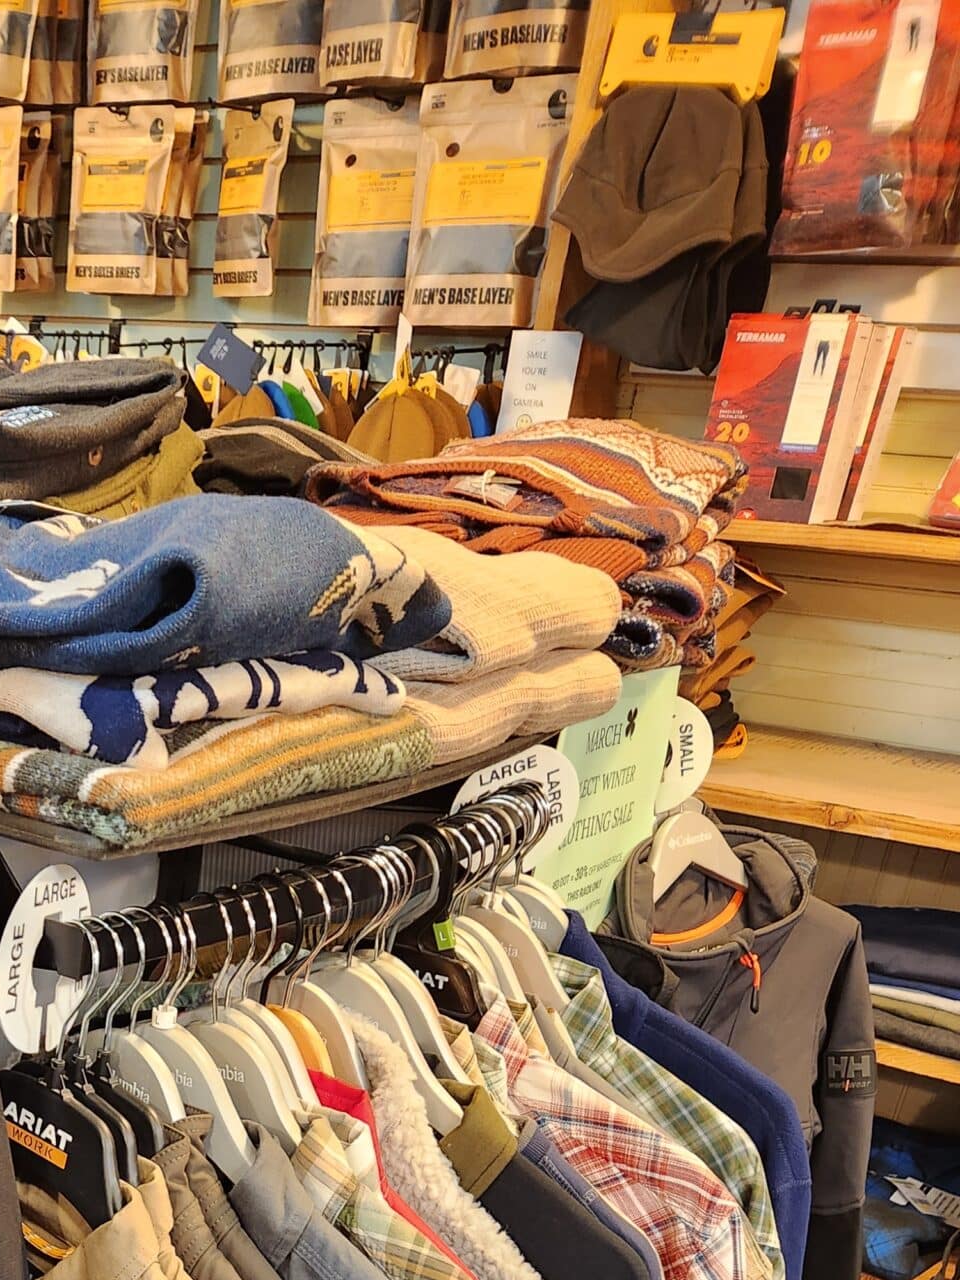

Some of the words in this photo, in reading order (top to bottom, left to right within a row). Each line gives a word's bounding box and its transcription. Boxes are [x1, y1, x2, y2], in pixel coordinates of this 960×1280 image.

[351, 38, 383, 66] LAYER
[463, 29, 498, 52] MEN'S
[140, 65, 168, 81] LAYER
[255, 58, 280, 77] BASE
[281, 57, 316, 74] LAYER
[351, 289, 376, 306] BASE
[377, 290, 405, 306] LAYE
[412, 288, 446, 305] MEN'S
[448, 288, 477, 305] BASE
[478, 288, 514, 305] LAYER
[736, 332, 786, 343] TERRAMAR
[527, 351, 548, 361] SMILE
[714, 421, 751, 444] 2.0
[585, 722, 623, 755] MARCH
[679, 723, 695, 777] SMALL
[479, 754, 538, 787] LARGE
[602, 764, 637, 792] WINTER
[546, 768, 563, 827] LARGE
[611, 801, 635, 830] SALE
[34, 877, 77, 908] LARGE
[6, 923, 26, 1015] LARGE
[827, 1055, 871, 1079] HH
[3, 1101, 73, 1151] ARIAT
[12, 1126, 54, 1161] WORK
